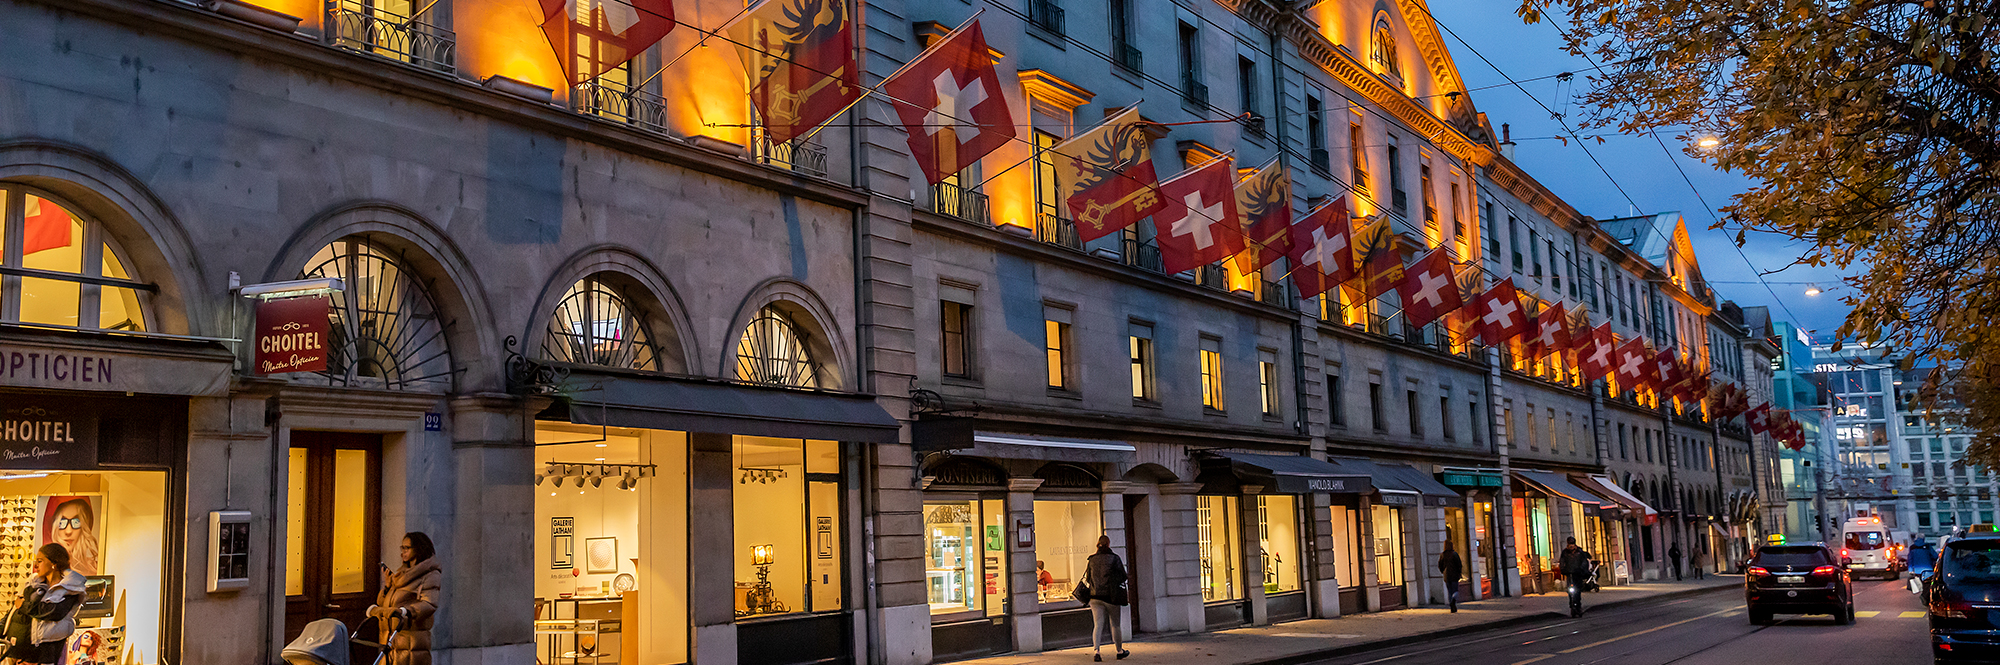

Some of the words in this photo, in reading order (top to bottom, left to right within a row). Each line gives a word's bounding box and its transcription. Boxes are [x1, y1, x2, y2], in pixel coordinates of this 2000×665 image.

[261, 332, 321, 353] CHOITEL
[290, 354, 320, 369] Opticien
[1813, 363, 1837, 373] SIN
[426, 414, 439, 428] 22
[0, 420, 74, 442] HOITEL
[935, 467, 1000, 484] CONFISERIE
[13, 546, 37, 563] Dio
